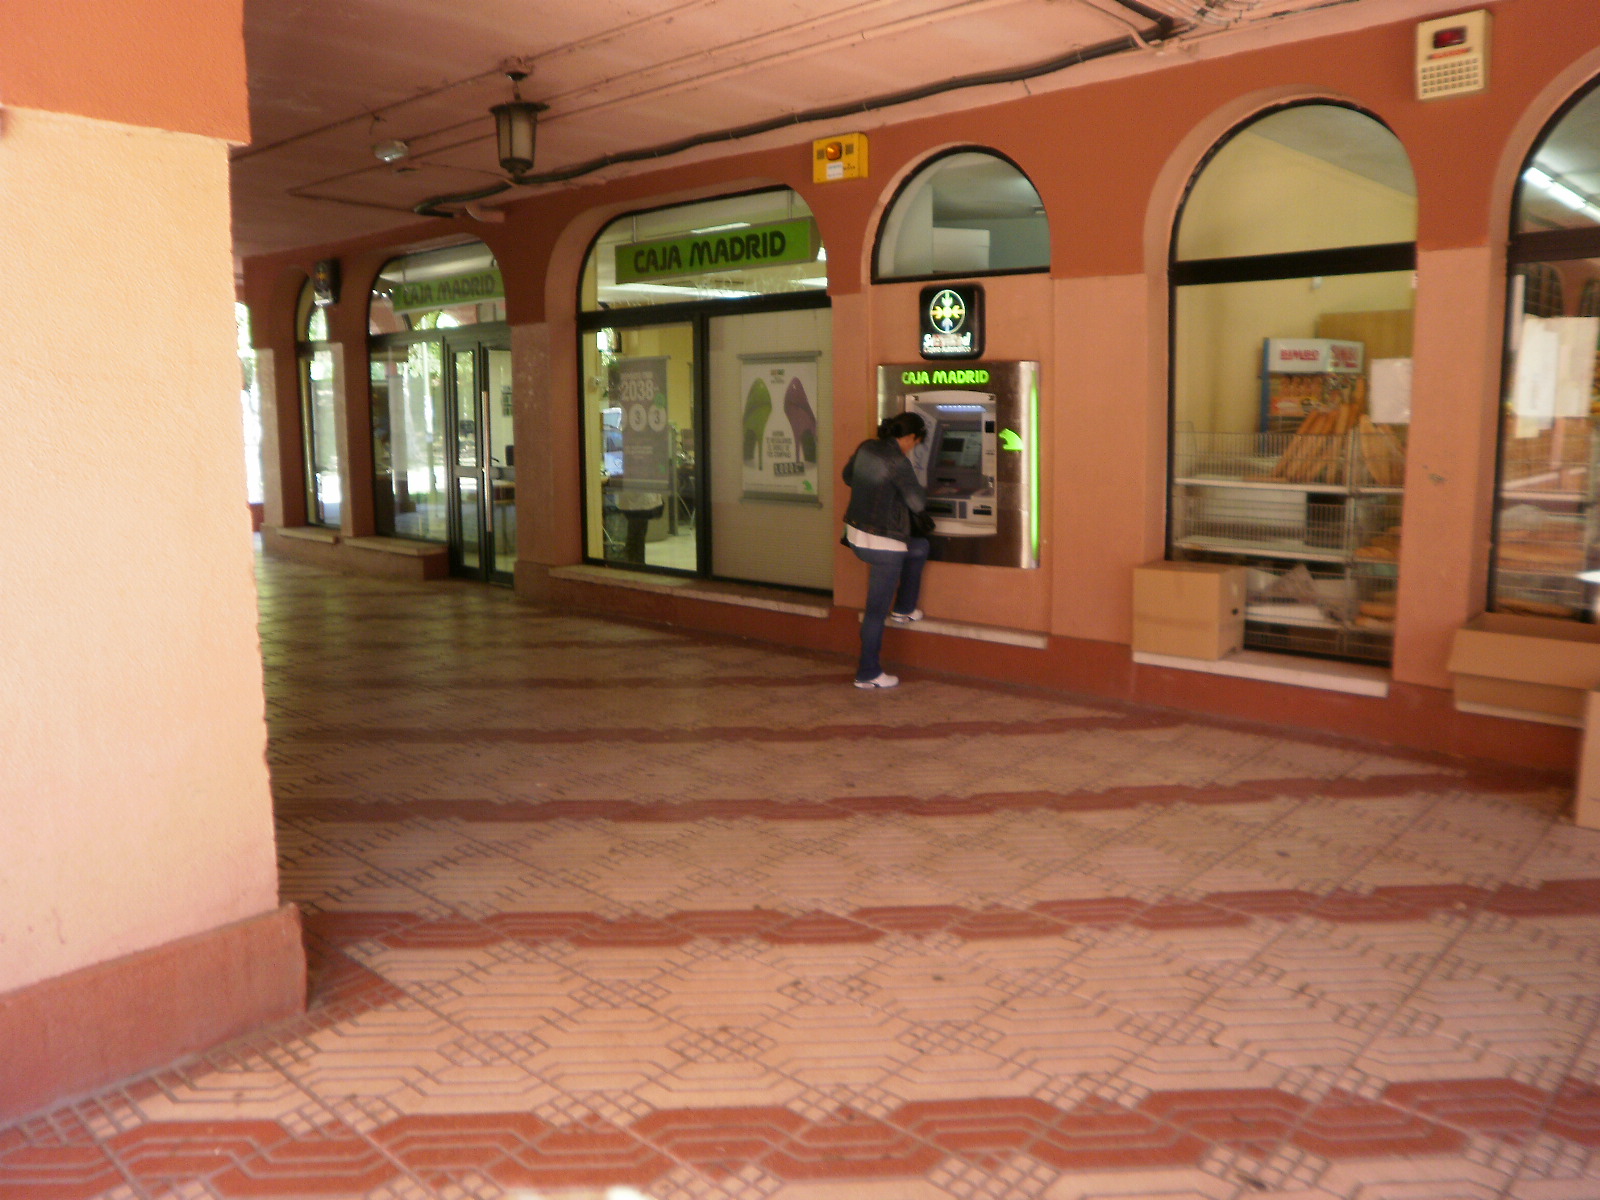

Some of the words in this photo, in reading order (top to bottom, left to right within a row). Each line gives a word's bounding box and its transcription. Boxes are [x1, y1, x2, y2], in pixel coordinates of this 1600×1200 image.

[633, 244, 682, 274] CAJA
[689, 230, 787, 267] MADRID
[403, 283, 433, 306] CAJA
[437, 274, 496, 301] MADRID
[901, 371, 931, 385] CAJA
[932, 369, 990, 384] MADRID
